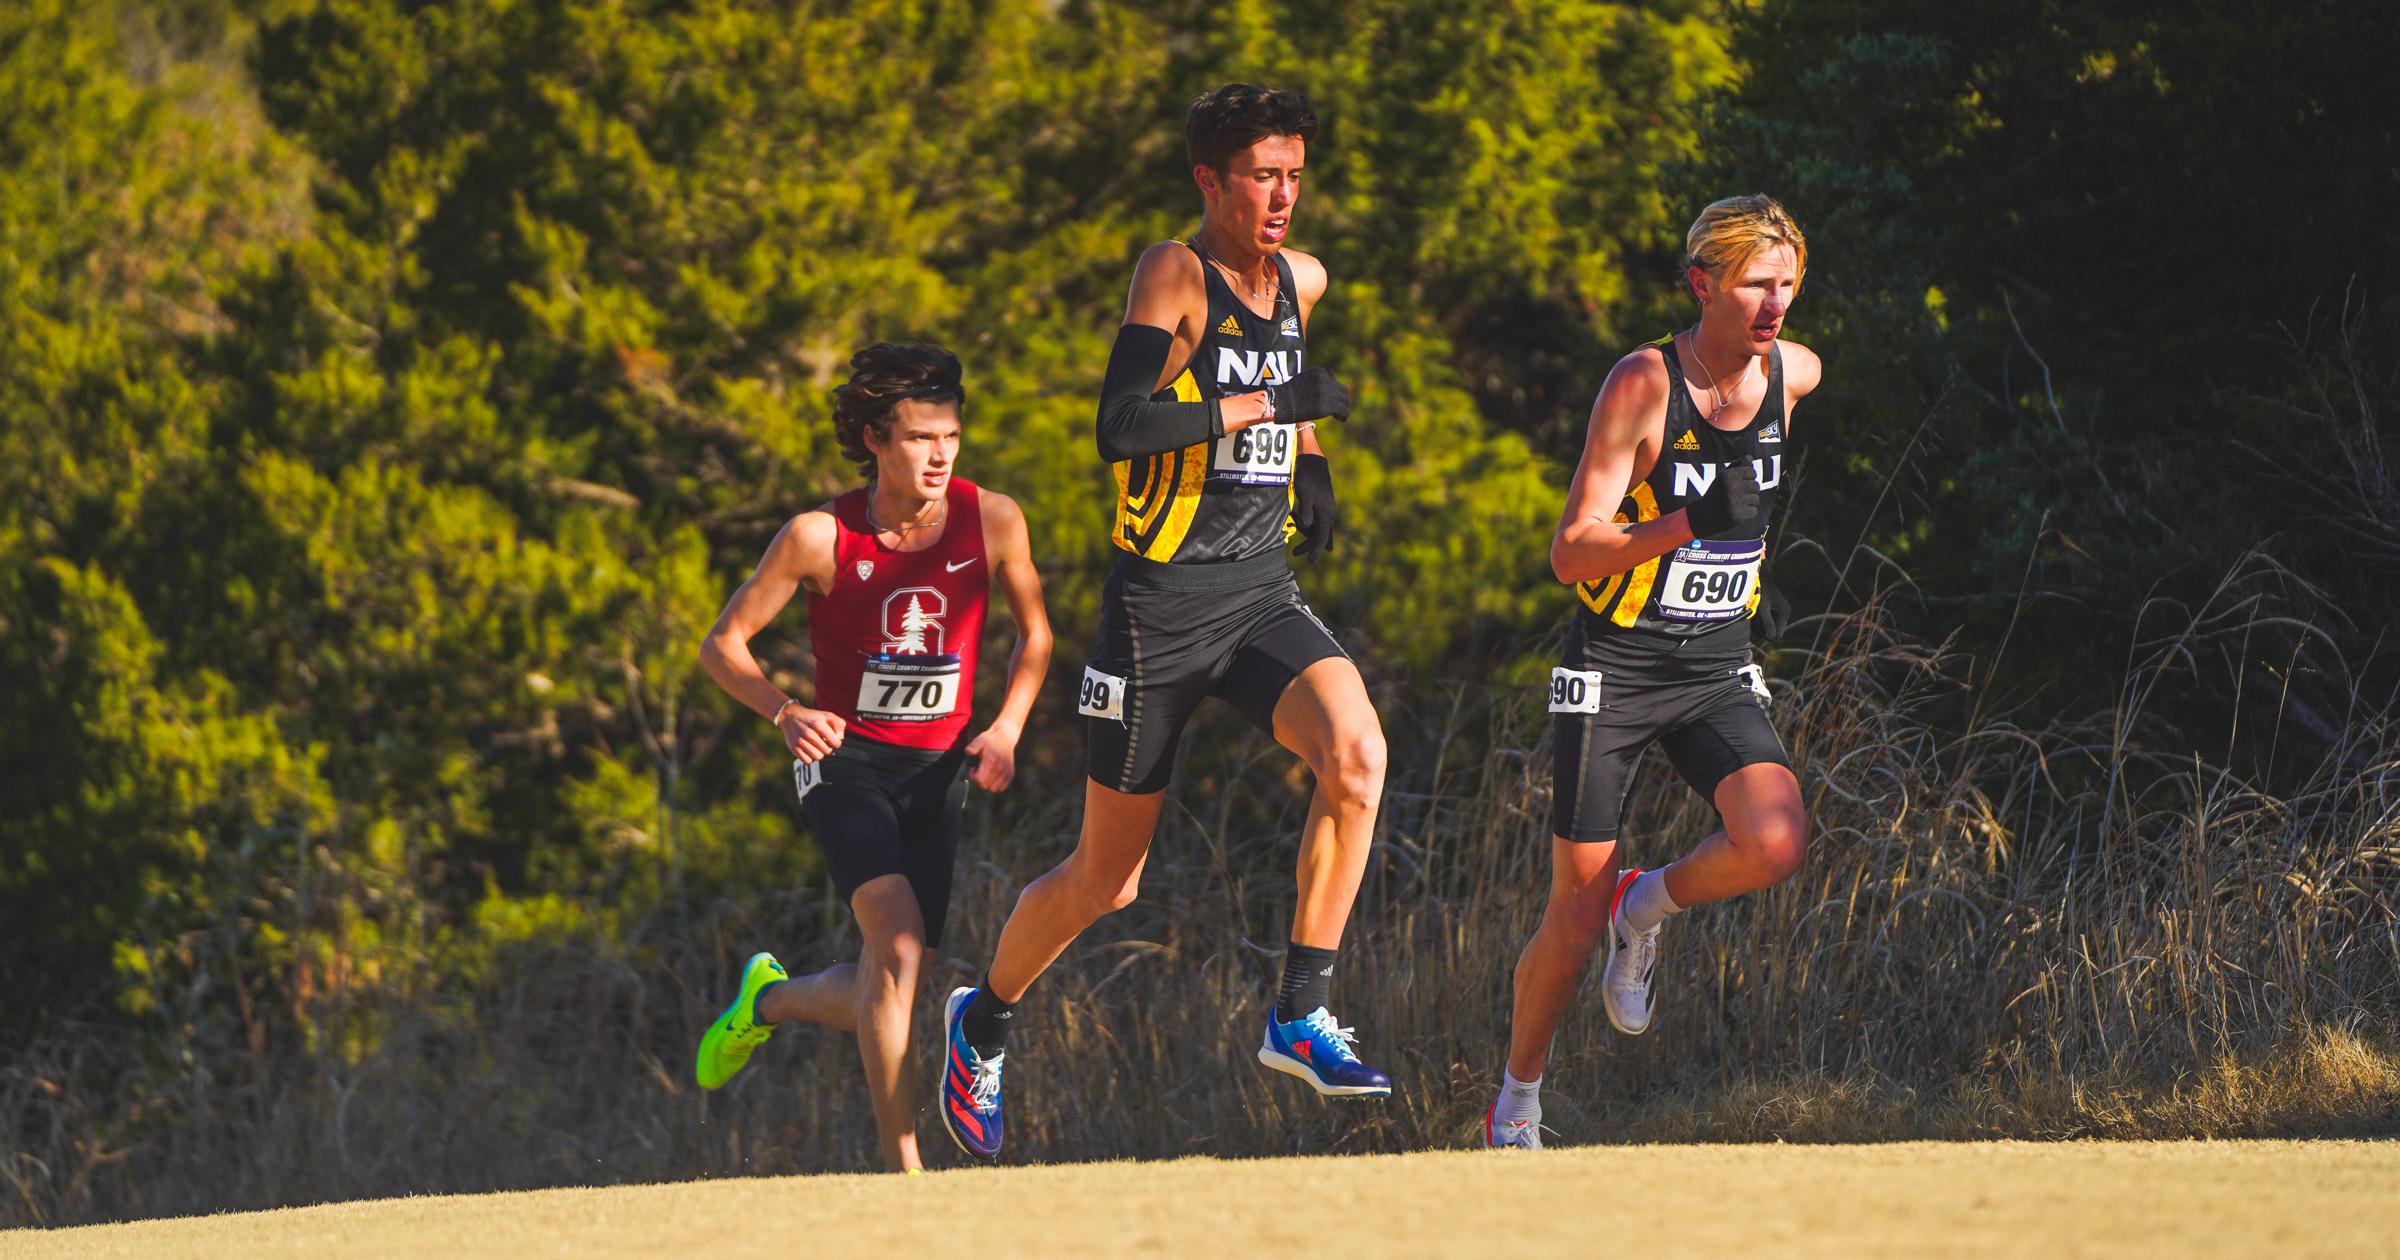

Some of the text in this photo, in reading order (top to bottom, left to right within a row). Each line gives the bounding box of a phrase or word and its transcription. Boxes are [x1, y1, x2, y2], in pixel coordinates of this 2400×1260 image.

[1218, 326, 1244, 337] adidas
[1217, 346, 1302, 387] NAU
[1233, 427, 1288, 466] 699
[1673, 442, 1700, 451] adidas
[1673, 454, 1781, 497] NU
[1687, 552, 1707, 560] CROSS
[1681, 570, 1748, 604] 690
[877, 680, 943, 708] 770
[1080, 676, 1110, 710] 99
